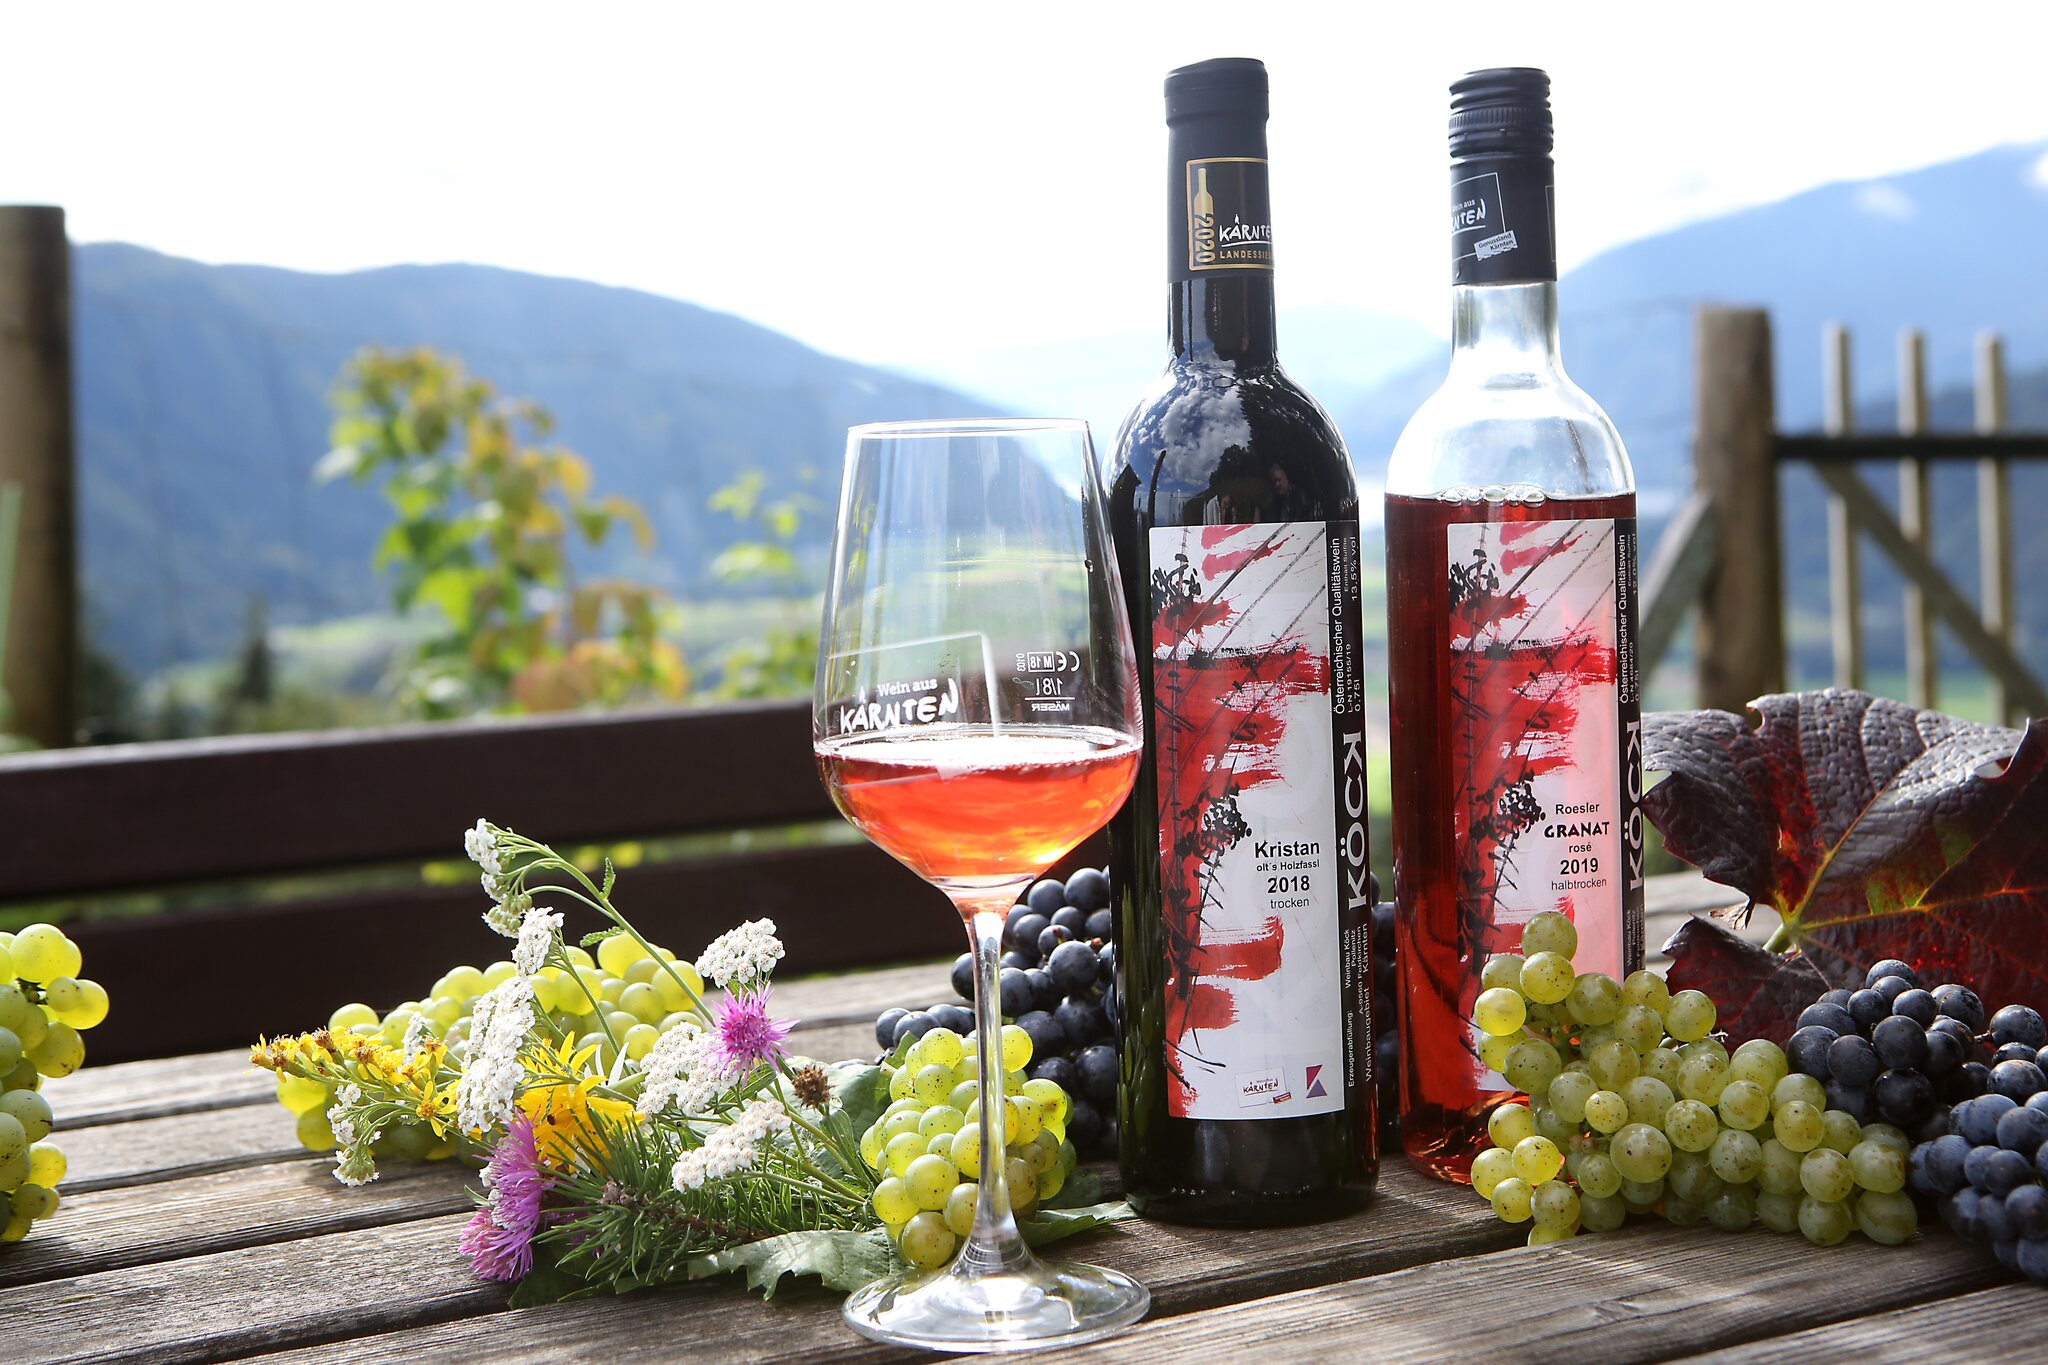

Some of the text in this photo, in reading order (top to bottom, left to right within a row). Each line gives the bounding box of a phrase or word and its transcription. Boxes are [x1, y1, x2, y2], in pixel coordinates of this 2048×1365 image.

[1463, 199, 1476, 208] aus
[1451, 198, 1486, 232] NTEN
[1193, 213, 1216, 263] 2020
[1478, 232, 1513, 249] Genussland
[1489, 239, 1514, 251] Kärnten
[1349, 536, 1358, 602] 13.5% vol
[1330, 538, 1345, 714] Österreichischer Qualitätswein
[1618, 534, 1628, 704] Österreichischer Qualitätswein
[877, 678, 938, 697] Wein aus
[1555, 802, 1600, 815] Roesler
[1624, 720, 1643, 891] KÖCK
[1340, 731, 1367, 910] KÖCK
[1544, 821, 1610, 838] GRANAT
[1254, 840, 1320, 858] Kristan
[1568, 842, 1592, 853] rosé
[1280, 859, 1320, 870] Holzfassl
[1560, 857, 1599, 875] 2019
[1267, 875, 1310, 894] 2018
[1551, 878, 1607, 890] halbtrocken
[1270, 898, 1310, 909] trocken
[1363, 987, 1372, 1082] Weinbaugebiet
[1346, 1010, 1355, 1087] Erzeugerabfüllung:
